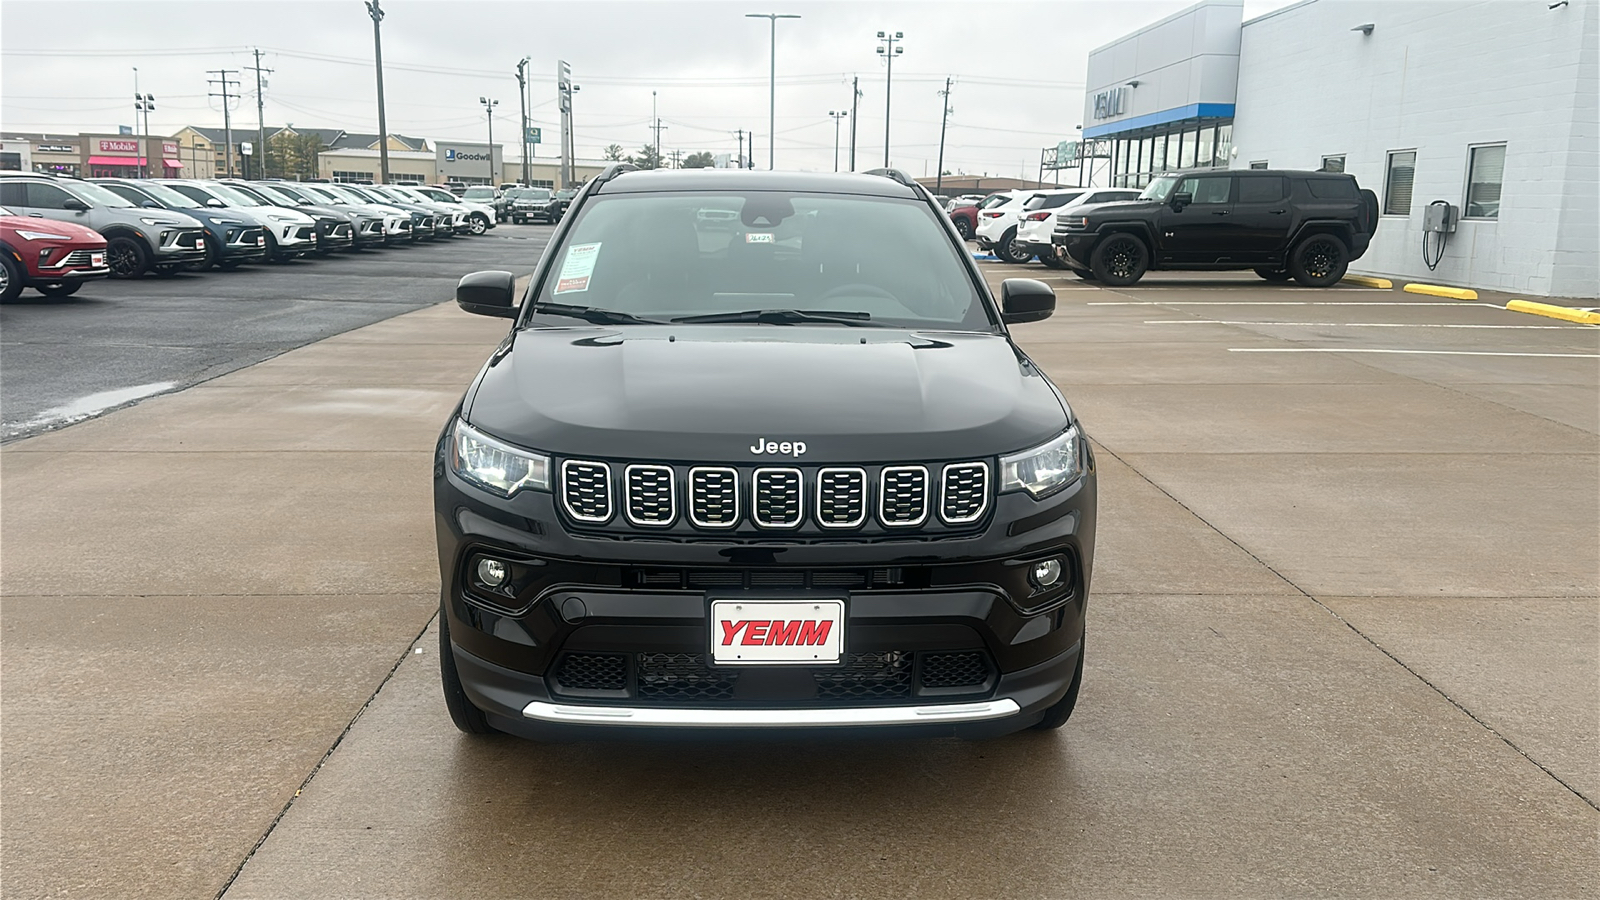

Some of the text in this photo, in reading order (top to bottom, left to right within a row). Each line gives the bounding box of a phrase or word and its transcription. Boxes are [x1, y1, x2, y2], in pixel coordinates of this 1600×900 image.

[109, 142, 136, 151] Mobile
[456, 152, 491, 161] Goodwil
[750, 438, 807, 457] Jeep
[721, 620, 833, 646] YEMM
